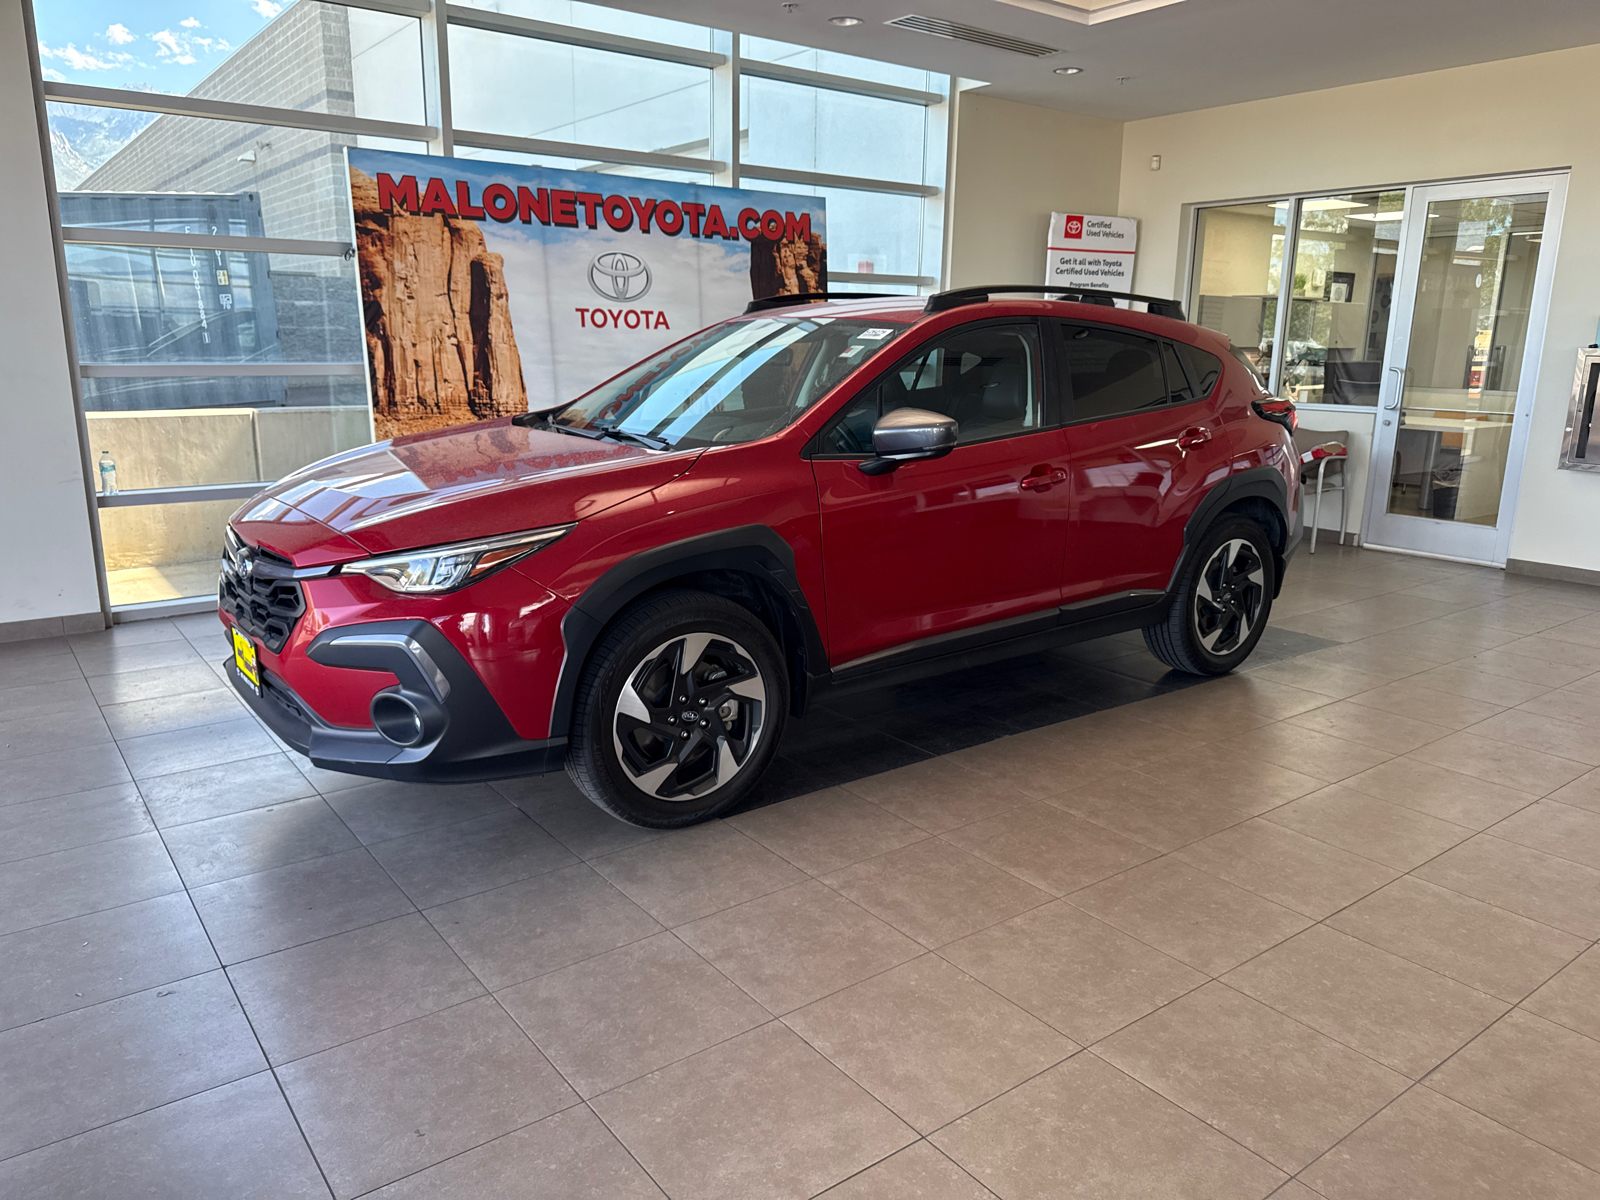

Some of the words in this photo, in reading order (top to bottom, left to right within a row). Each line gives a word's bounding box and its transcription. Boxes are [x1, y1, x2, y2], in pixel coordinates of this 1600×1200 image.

[376, 173, 812, 243] MALONETOYOTA.COM
[1087, 220, 1112, 229] Certified
[1102, 231, 1124, 239] Vehicles
[1060, 257, 1072, 265] Get
[1078, 258, 1087, 266] all
[1102, 259, 1123, 268] Toyota
[1055, 267, 1083, 276] Certified
[1083, 268, 1099, 276] Used
[1100, 269, 1125, 277] Vehicles
[575, 308, 671, 331] TOYOTA
